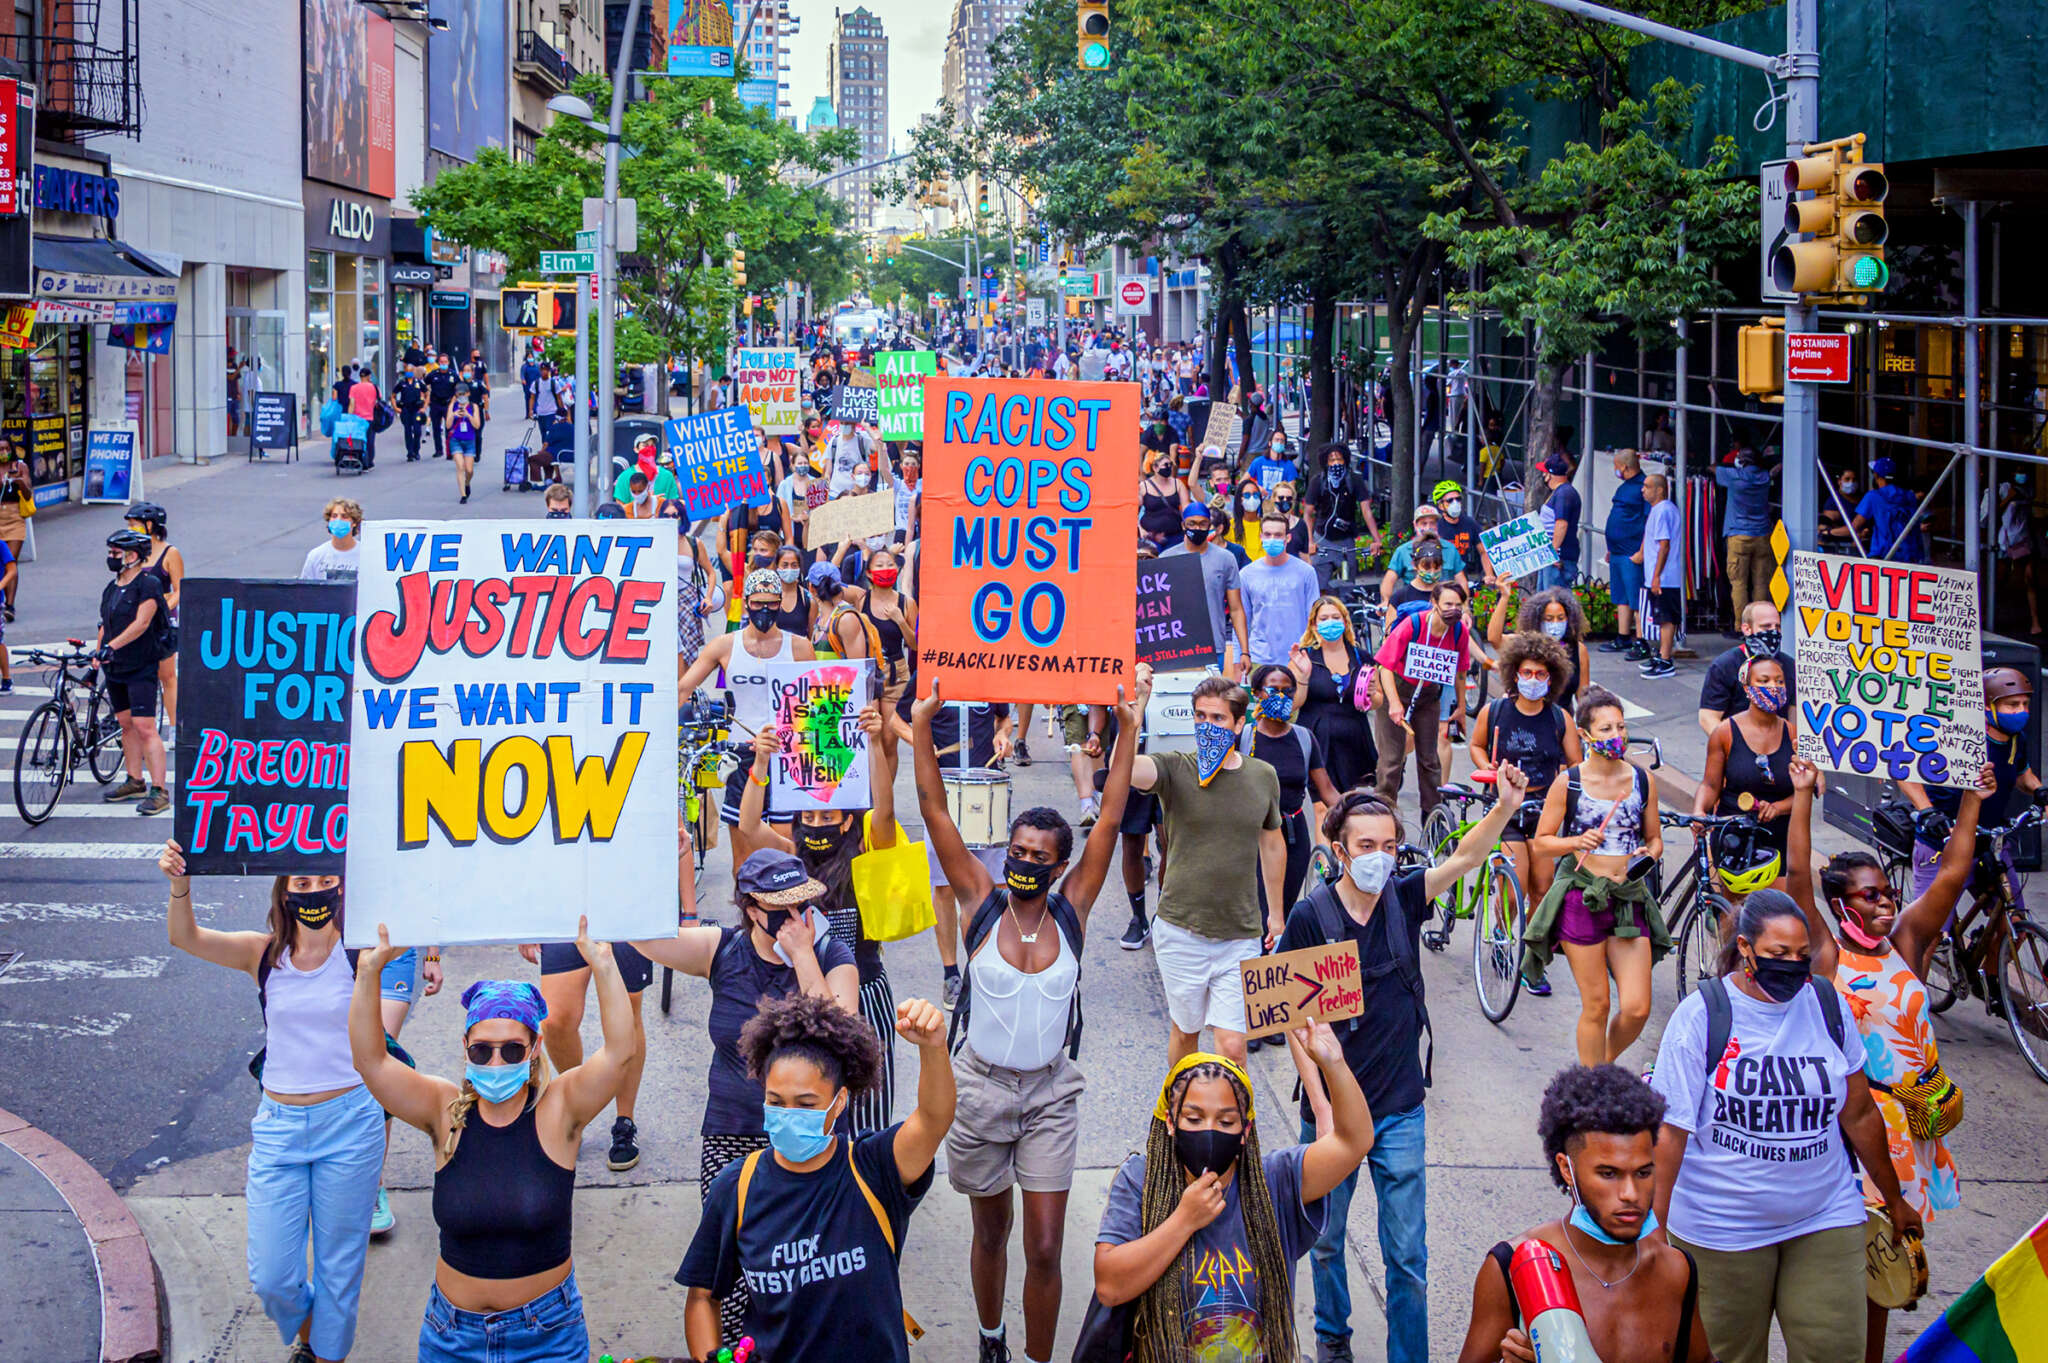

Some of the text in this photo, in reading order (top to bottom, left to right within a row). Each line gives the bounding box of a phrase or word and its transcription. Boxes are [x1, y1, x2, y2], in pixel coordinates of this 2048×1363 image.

[1767, 180, 1782, 201] ALL
[330, 198, 374, 242] ALDO
[542, 254, 591, 271] Elm Pl
[394, 270, 431, 280] ALDO
[1031, 310, 1042, 319] 15
[1791, 338, 1840, 349] NO STANDING
[1791, 349, 1822, 359] Anytime
[740, 350, 796, 369] POLICE
[885, 355, 922, 377] ALL
[739, 368, 798, 384] are NOT
[878, 373, 927, 390] BLACK
[842, 398, 876, 409] LIVES
[881, 386, 922, 408] LIVE
[761, 403, 800, 425] LAW
[879, 411, 924, 434] MATT
[944, 390, 1111, 451] RACIST
[674, 411, 738, 442] WHITE
[93, 433, 130, 445] WE FIX
[673, 430, 757, 467] PRIVILEGE
[90, 448, 130, 461] PHONES
[691, 456, 749, 483] IS THE
[687, 471, 765, 511] PROBLEM
[964, 456, 1092, 513] COPS
[385, 533, 654, 577] WE WANT
[952, 516, 1092, 573] MUST
[1794, 555, 1817, 567] BLACK
[1795, 579, 1823, 592] MATTER
[1817, 560, 1939, 624] VOTE
[1932, 589, 1974, 607] VOTES
[971, 581, 1066, 648] GO
[1932, 601, 1977, 619] MATTER
[361, 571, 665, 684] JUSTICE
[1799, 606, 1909, 649] VOTE
[1912, 624, 1972, 641] REPRESENT
[1936, 615, 1977, 632] #VOTAR
[200, 598, 356, 675] JUSTIC
[1798, 639, 1824, 649] VOTE
[1912, 634, 1972, 651] YOUR VOICE
[922, 649, 1124, 675] #BLACKLIVESMATTER
[1155, 649, 1178, 662] STILL
[1413, 659, 1452, 674] BLACK
[1798, 649, 1851, 667] PROGRESS
[1848, 641, 1954, 682] VOTE
[1409, 668, 1454, 684] PEOPLE
[1798, 676, 1826, 687] VOTES
[1951, 668, 1981, 679] FIGHT
[1960, 679, 1979, 688] FOR
[244, 673, 344, 722] FOR
[1798, 686, 1835, 700] MATTER
[1826, 667, 1956, 721] VOTE
[362, 682, 654, 729] WE WANT IT
[1949, 698, 1984, 711] RIGHTS
[1802, 700, 1942, 754] VOTE
[186, 728, 349, 790] BREON
[1823, 726, 1949, 784] Vote
[1939, 737, 1986, 766] MATTERS
[397, 732, 650, 851] NOW
[186, 789, 348, 855] TAYLO
[299, 906, 320, 915] BLACK
[1244, 963, 1293, 995] BLACK
[1314, 952, 1358, 982] White
[1318, 984, 1362, 1015] Feelings
[1735, 1055, 1831, 1096] CAN'T
[1713, 1089, 1837, 1134] BREATHE
[1712, 1127, 1829, 1163] BLACK LIVES MATTER
[771, 1233, 821, 1267] FUCK
